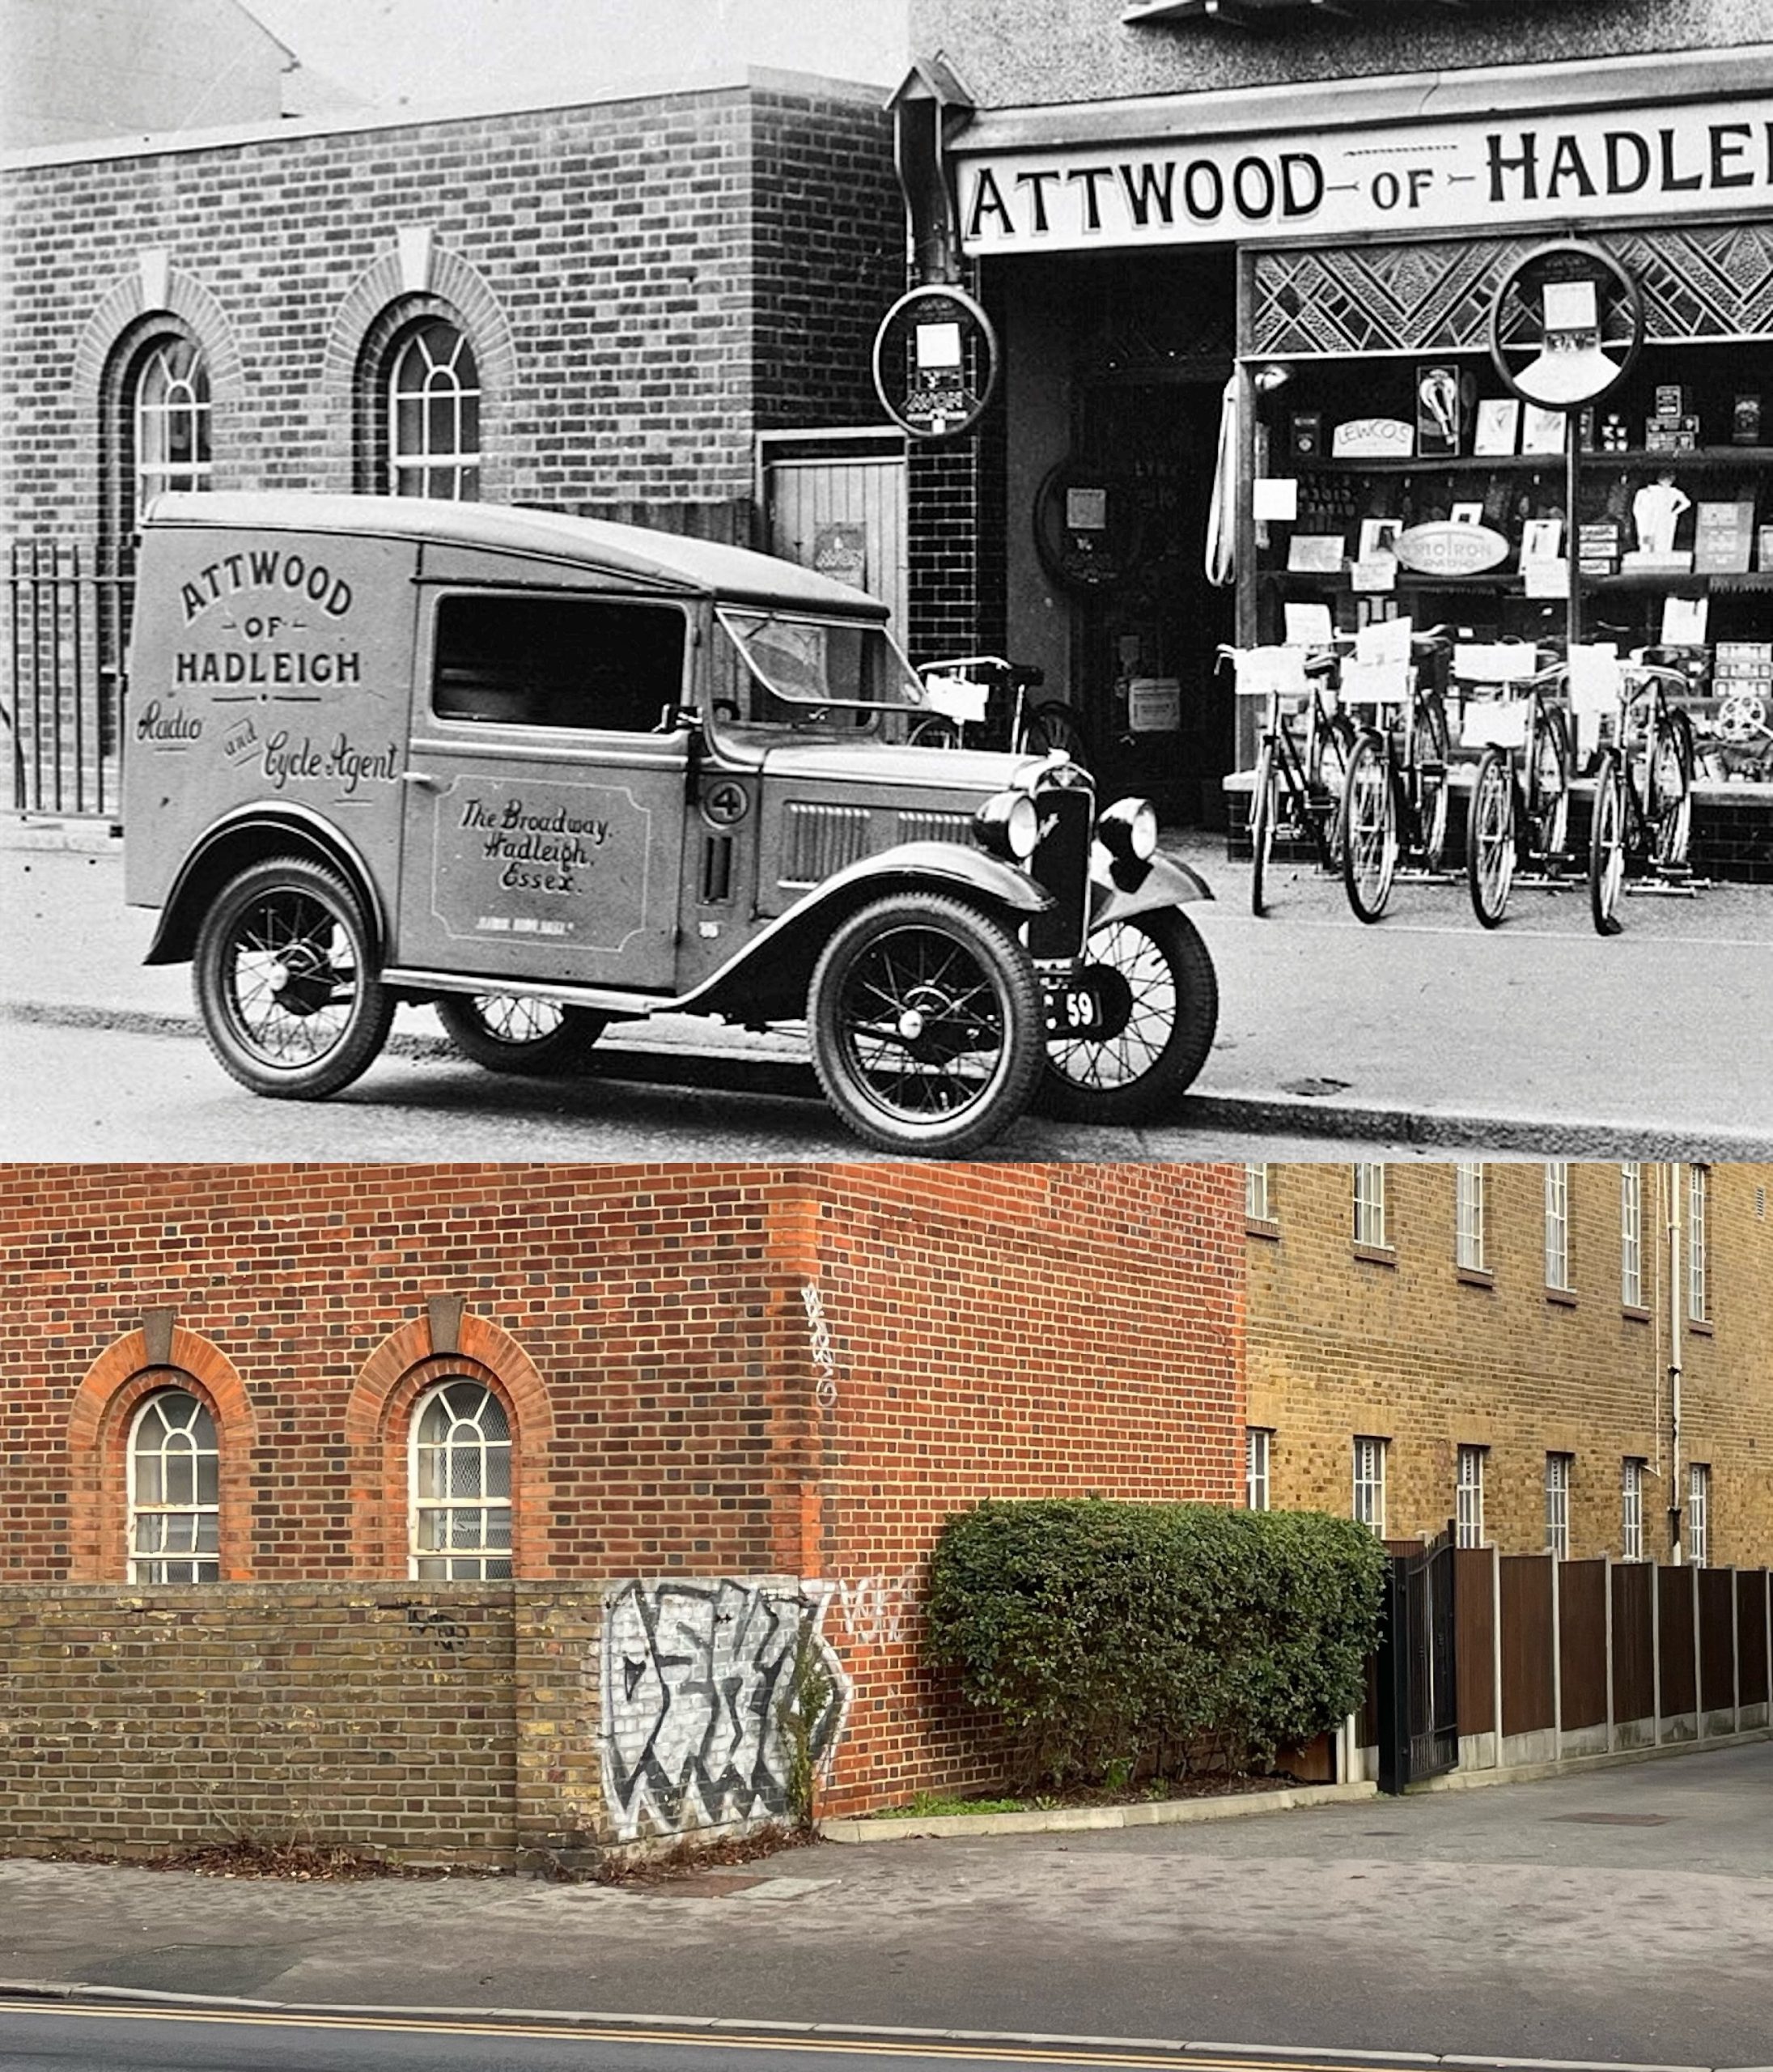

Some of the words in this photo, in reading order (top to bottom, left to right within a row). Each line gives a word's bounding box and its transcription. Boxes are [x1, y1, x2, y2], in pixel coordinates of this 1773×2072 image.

[970, 153, 1325, 236] ATTWOOD
[1372, 169, 1434, 210] OF
[181, 551, 352, 620] ATTWOOD
[244, 617, 283, 638] OF
[176, 652, 360, 682] HADLEIGH
[138, 699, 201, 741] Radio
[264, 731, 323, 790] Cycle
[325, 732, 398, 793] Agent
[462, 798, 497, 826] The
[713, 787, 740, 817] 4
[1066, 991, 1094, 1028] 59
